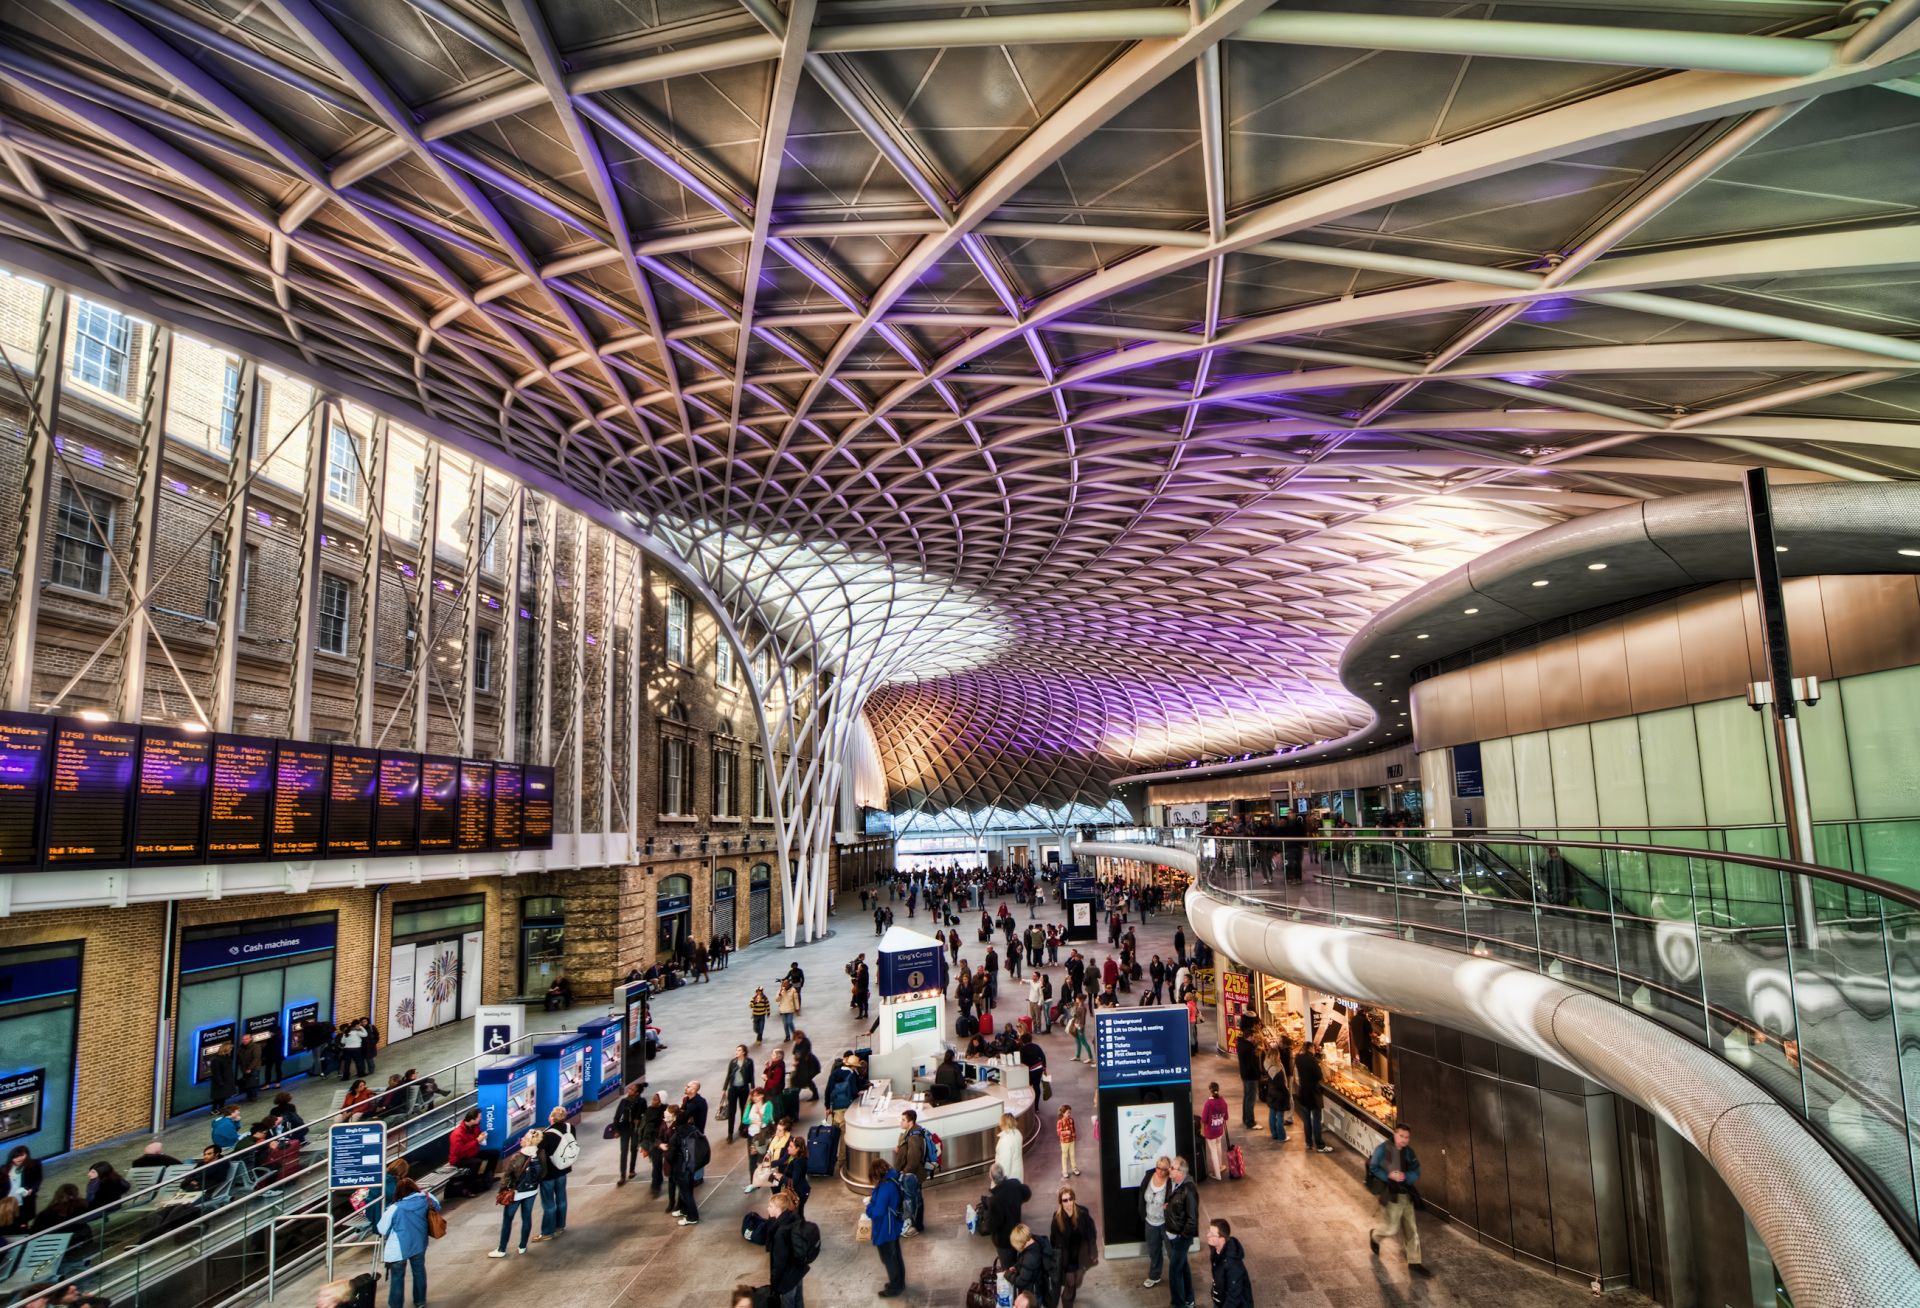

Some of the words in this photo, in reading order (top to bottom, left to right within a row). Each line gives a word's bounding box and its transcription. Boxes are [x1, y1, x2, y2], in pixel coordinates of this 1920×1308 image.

[93, 734, 128, 743] Platform
[173, 741, 202, 749] Platform
[144, 747, 180, 755] Cambridge
[216, 752, 244, 760] Hertford
[68, 846, 95, 854] Trains
[243, 943, 263, 953] Cash
[264, 939, 300, 949] machines
[898, 952, 915, 960] King's
[303, 1006, 316, 1014] Cash
[249, 1020, 261, 1028] Free
[262, 1017, 275, 1025] Cash
[203, 1031, 216, 1039] Free
[217, 1027, 231, 1035] Cash
[584, 1056, 592, 1081] Tickets
[17, 1075, 38, 1085] Cash
